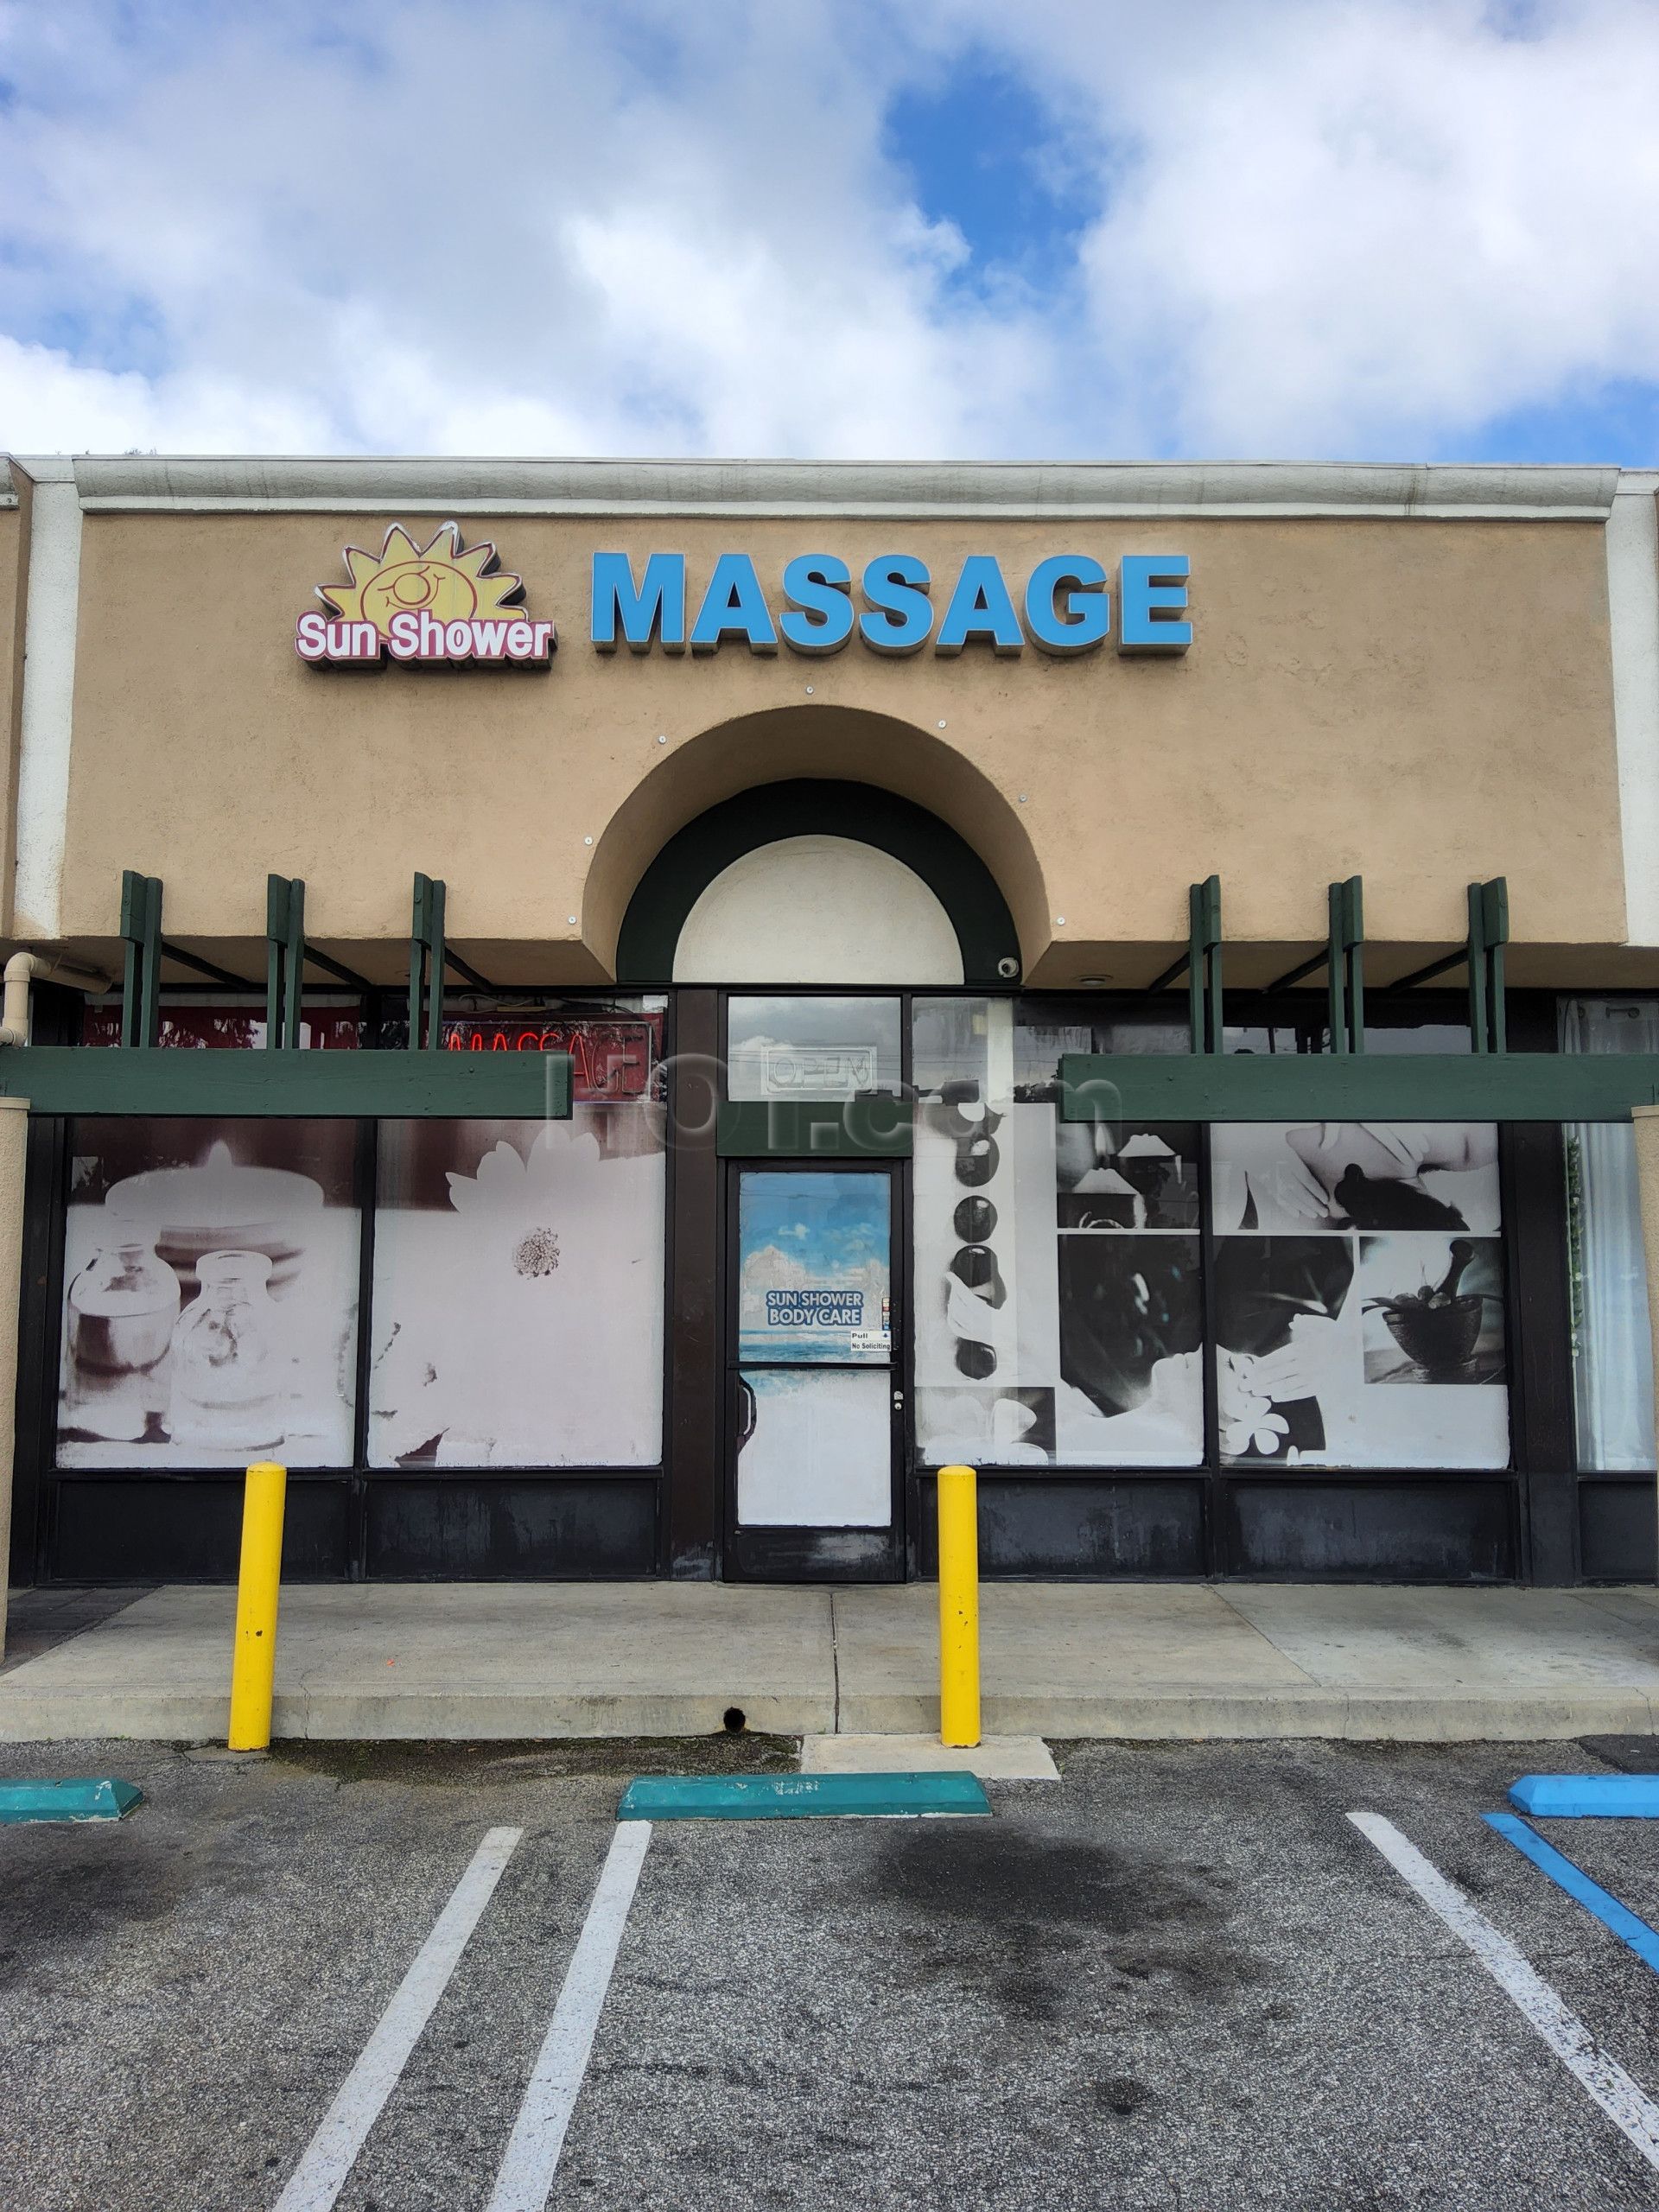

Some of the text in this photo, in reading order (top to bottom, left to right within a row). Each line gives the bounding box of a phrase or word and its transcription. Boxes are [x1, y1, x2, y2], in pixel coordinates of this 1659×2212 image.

[591, 551, 1192, 652] MASSAGE
[297, 608, 552, 658] Sun Shower
[774, 1057, 869, 1087] OPEN
[767, 1293, 862, 1306] SUN SHOWER
[770, 1308, 860, 1324] BODY CARE
